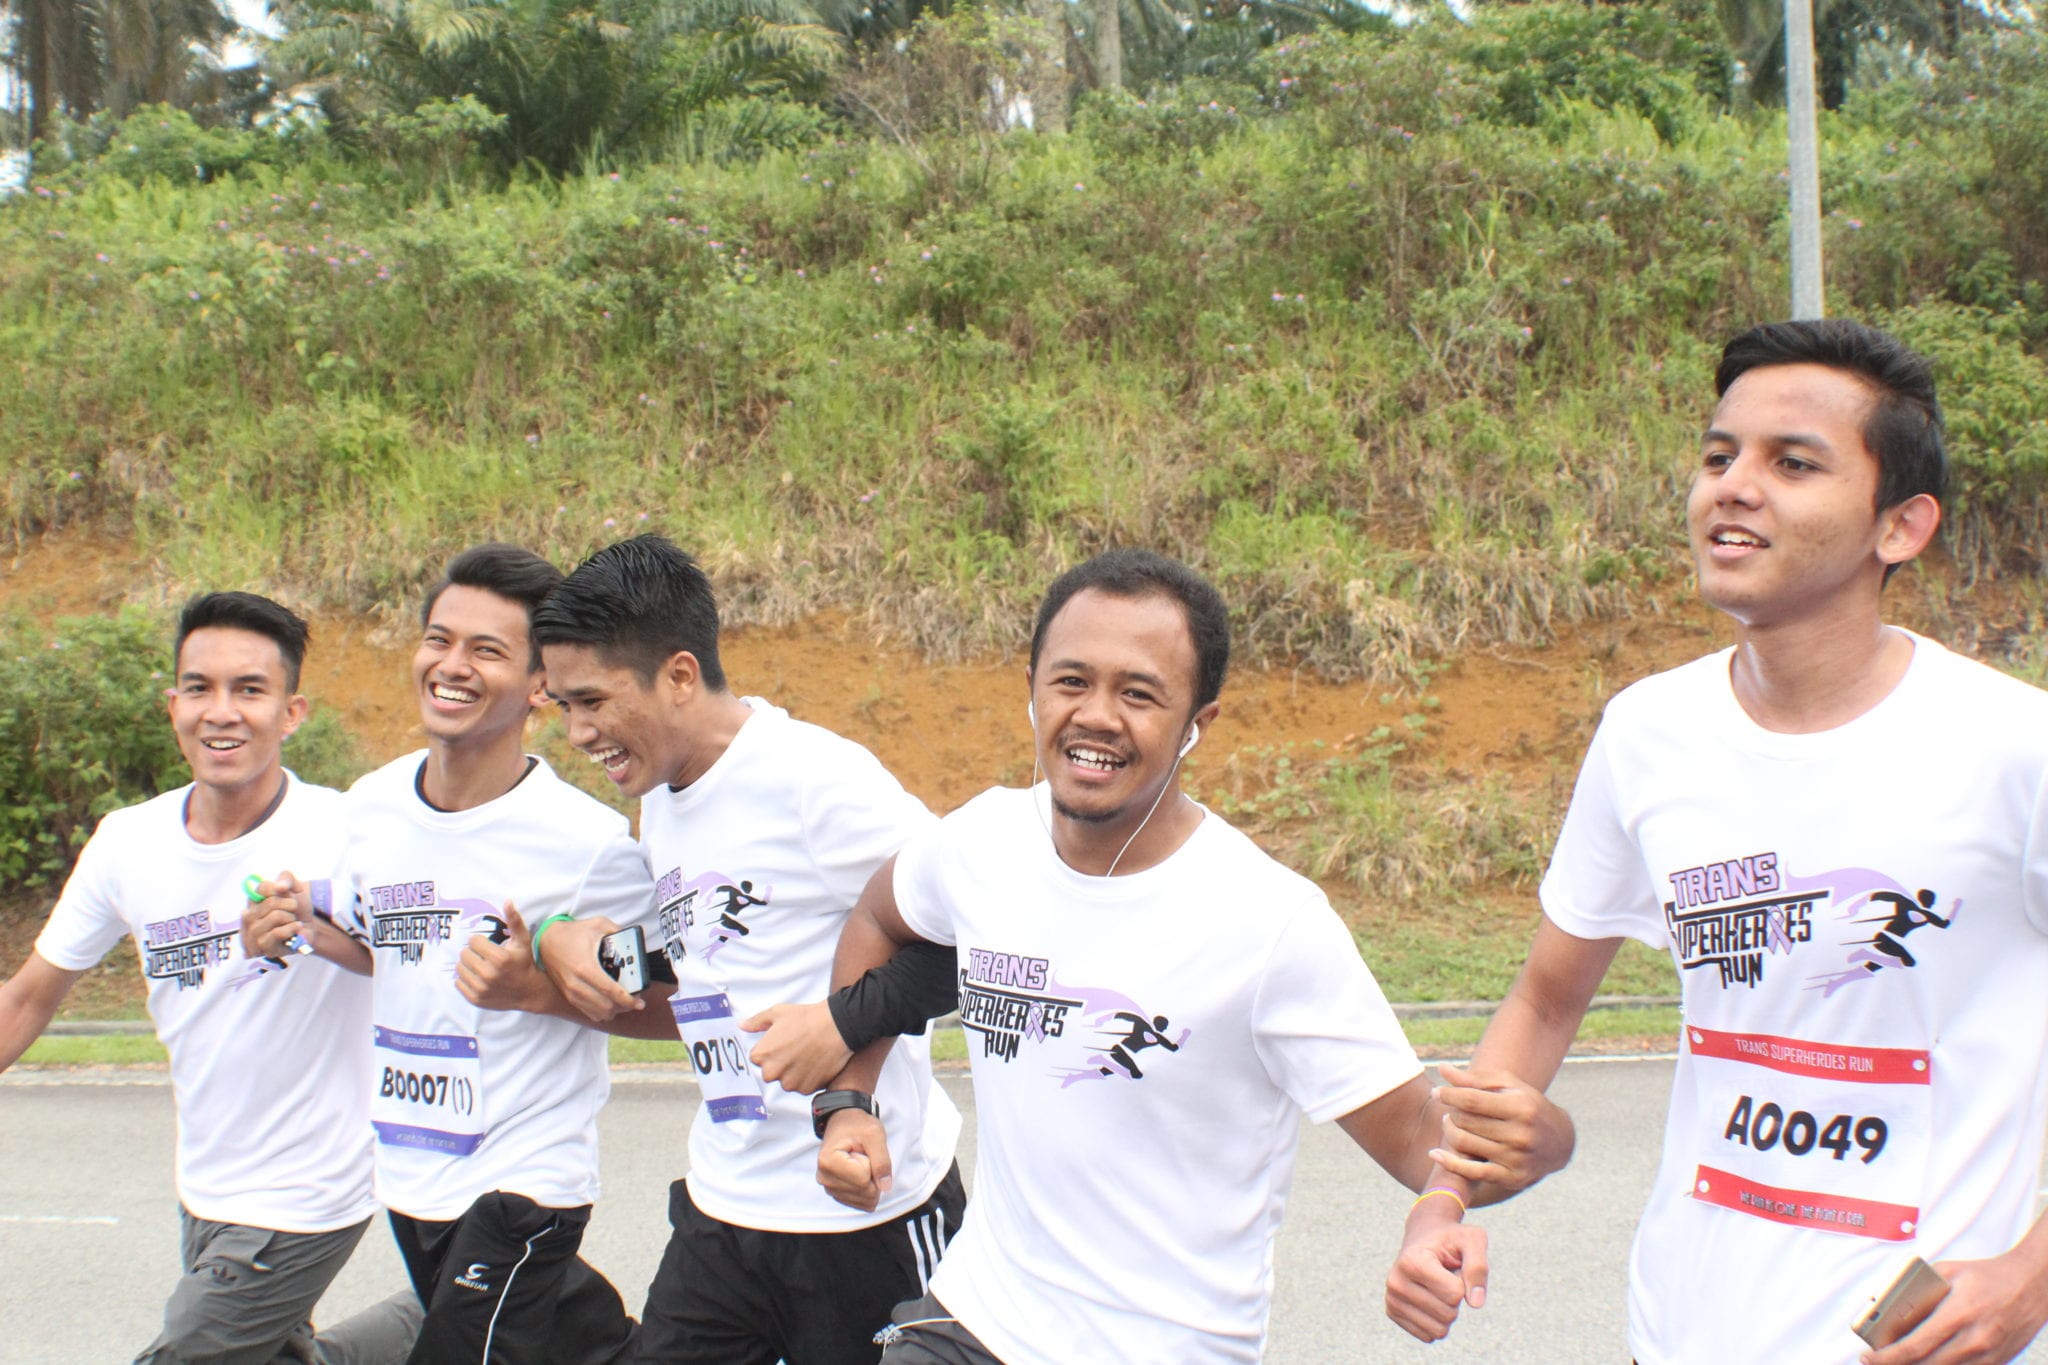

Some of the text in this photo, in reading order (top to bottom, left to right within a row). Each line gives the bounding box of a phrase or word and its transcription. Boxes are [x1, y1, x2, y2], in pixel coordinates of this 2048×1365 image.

[370, 881, 435, 912] TRANS
[1669, 852, 1780, 909] TRANS
[144, 910, 211, 945] TRANS
[401, 943, 425, 966] RUN
[969, 948, 1049, 990] TRANS
[1718, 952, 1762, 990] RUN
[179, 968, 205, 991] RUN
[985, 1030, 1020, 1063] RUN
[1736, 1039, 1874, 1073] TRANS SUPERHEROES RUN
[1724, 1095, 1888, 1165] A0049
